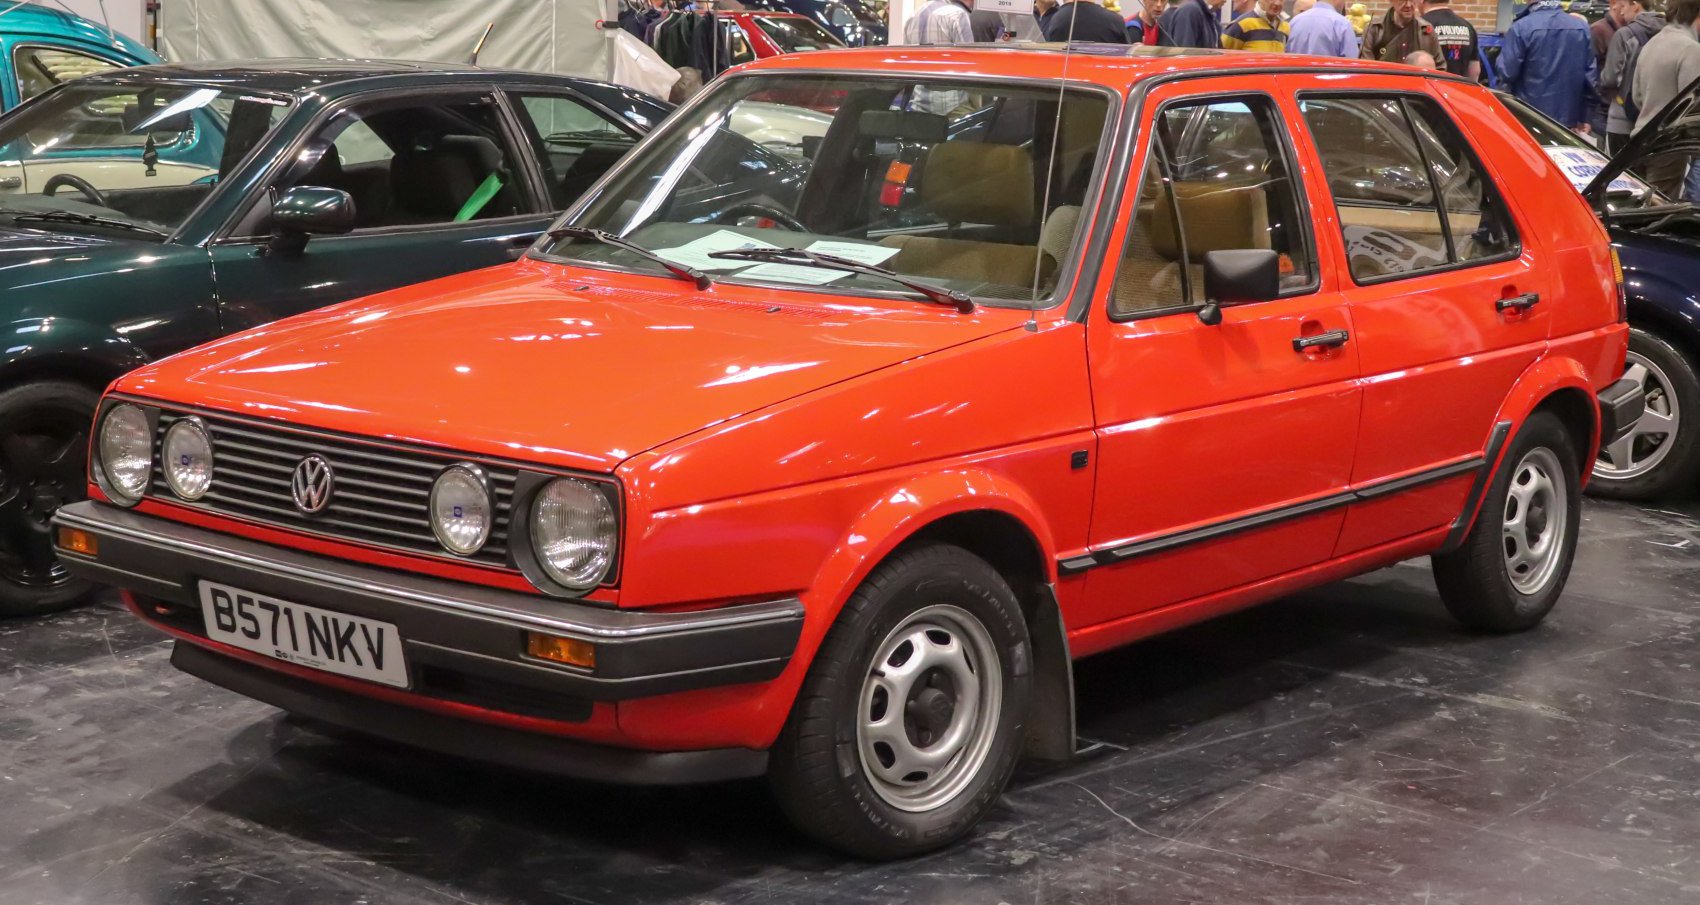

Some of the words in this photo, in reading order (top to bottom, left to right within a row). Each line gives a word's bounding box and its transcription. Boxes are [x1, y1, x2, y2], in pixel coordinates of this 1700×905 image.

[294, 456, 331, 512] VW
[210, 587, 298, 652] B571
[304, 611, 384, 671] NKV
